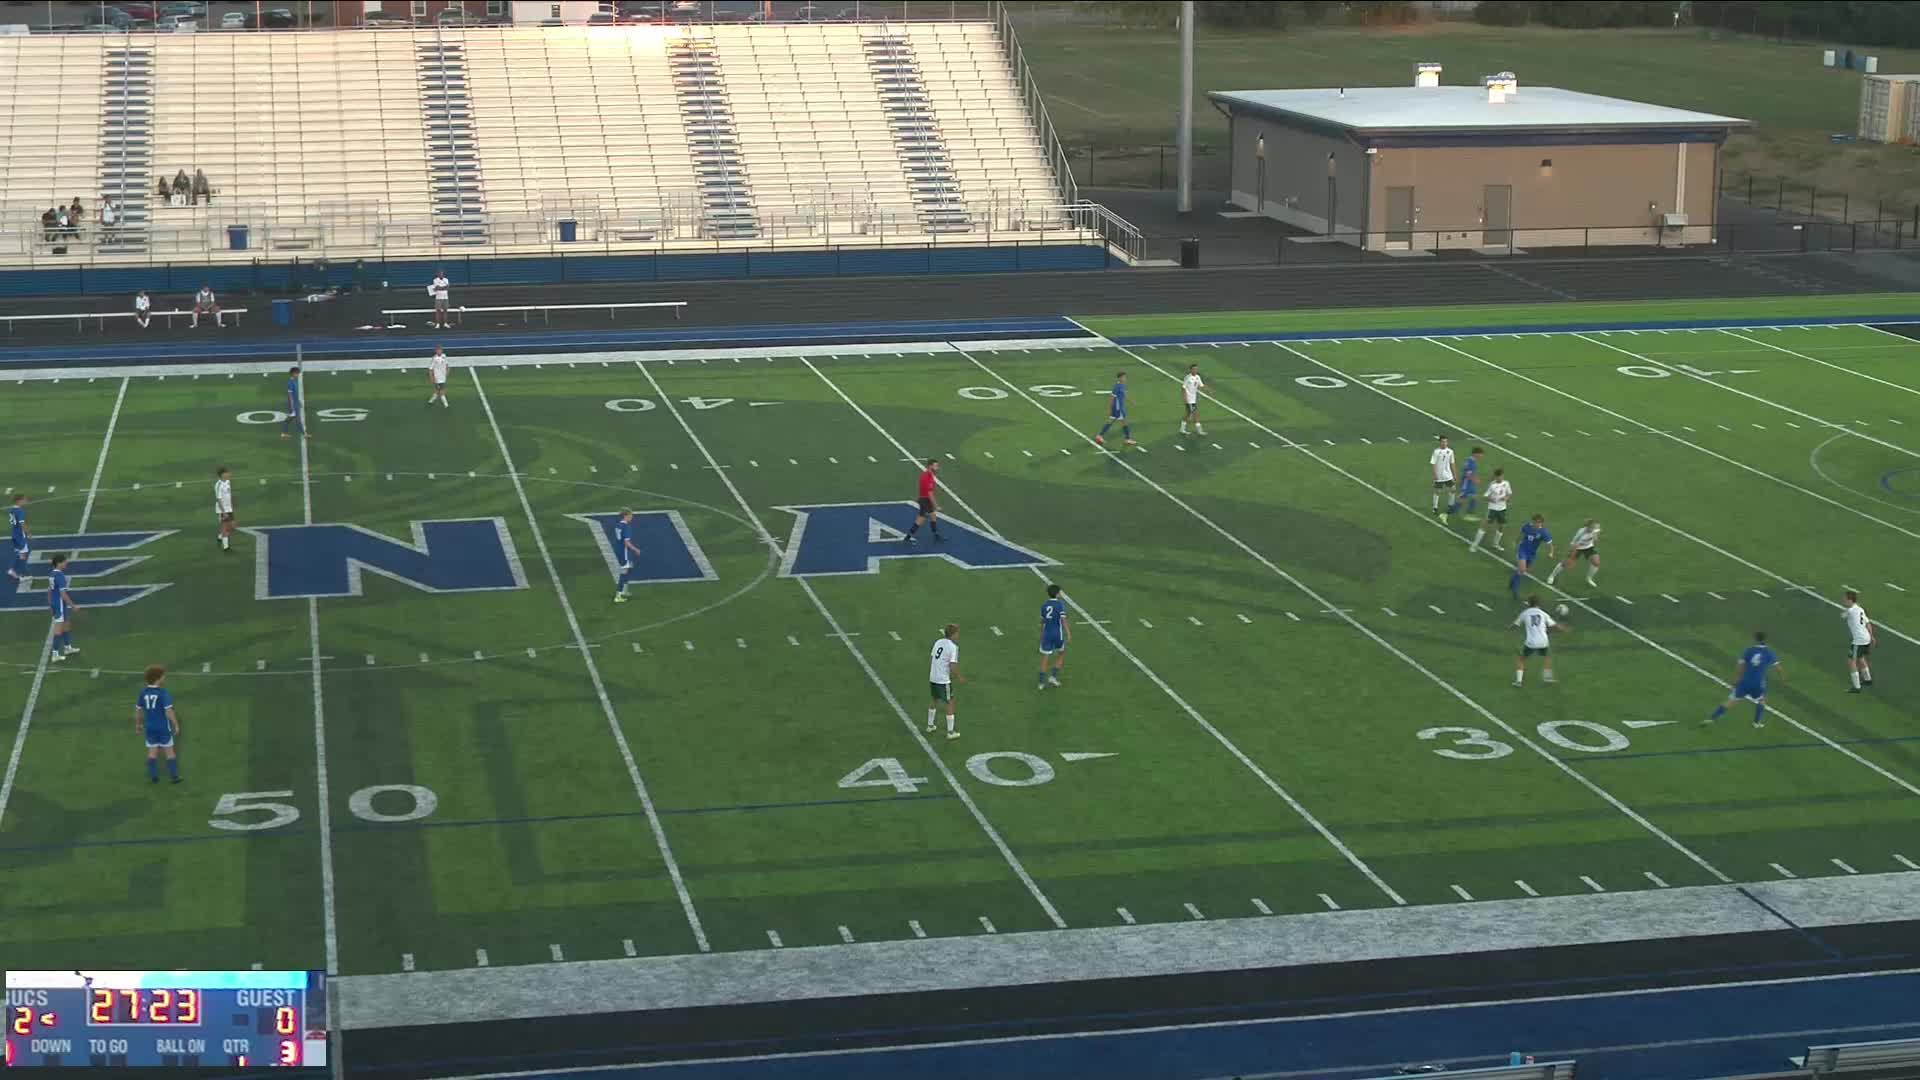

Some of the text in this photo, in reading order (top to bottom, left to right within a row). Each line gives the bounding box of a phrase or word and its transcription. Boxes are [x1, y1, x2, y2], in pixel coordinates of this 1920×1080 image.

[1294, 373, 1419, 388] 20
[957, 384, 1083, 400] 30
[604, 396, 735, 412] 40
[235, 407, 369, 424] 50
[1045, 605, 1054, 619] 2
[935, 646, 944, 660] 9
[143, 694, 159, 709] 17
[1415, 720, 1631, 761] 30
[836, 750, 1056, 794] 40
[207, 784, 439, 831] 50
